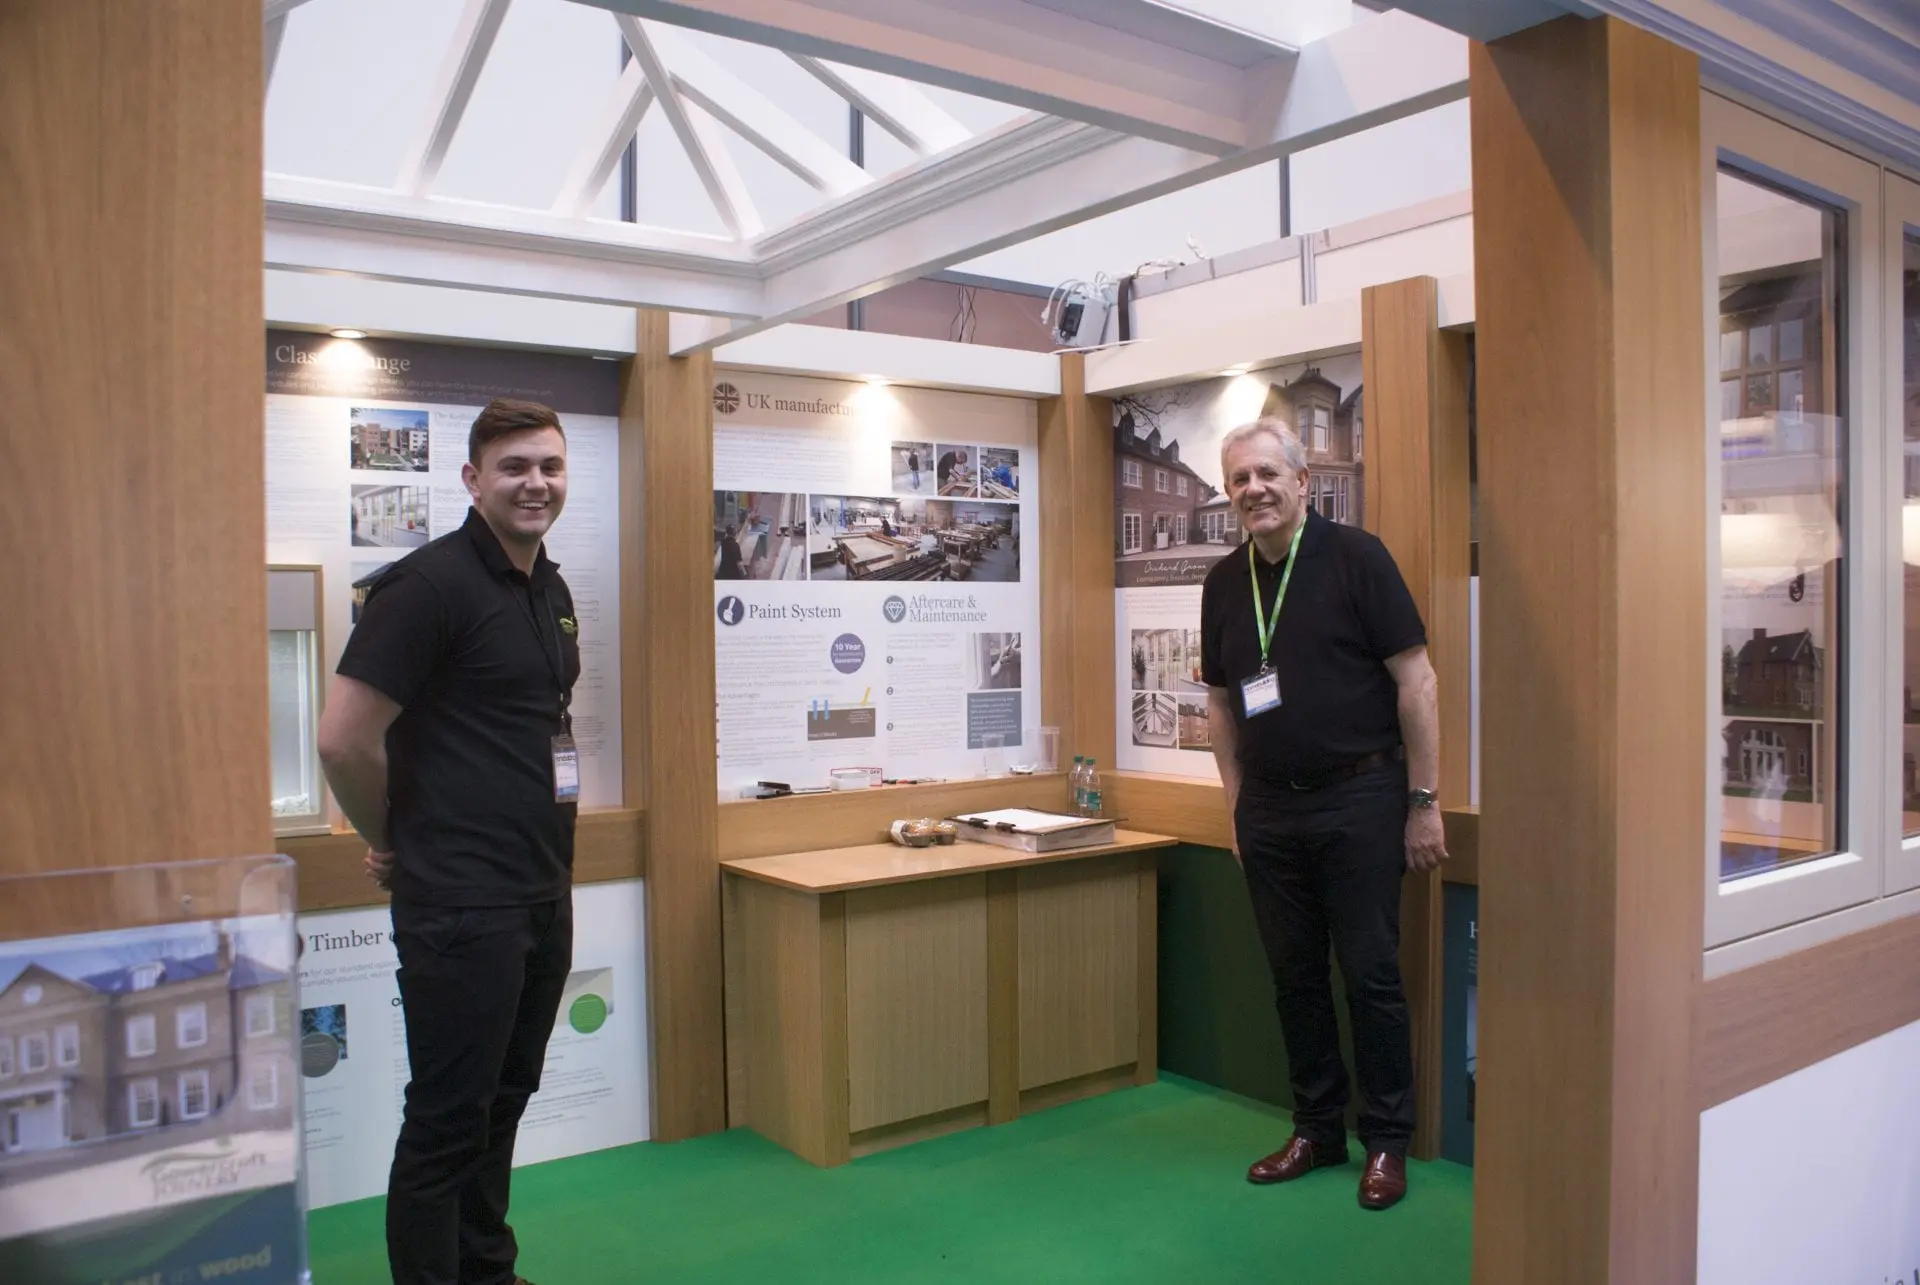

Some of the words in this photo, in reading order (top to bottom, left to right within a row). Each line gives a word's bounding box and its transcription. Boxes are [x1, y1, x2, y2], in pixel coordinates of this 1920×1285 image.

[746, 393, 770, 409] UK
[909, 594, 964, 609] Aftercare
[967, 595, 977, 608] &
[749, 604, 787, 619] Paint
[791, 604, 842, 622] System
[909, 609, 987, 623] Maintenance
[835, 643, 844, 651] 10
[845, 643, 862, 651] Year
[309, 930, 383, 952] Timber
